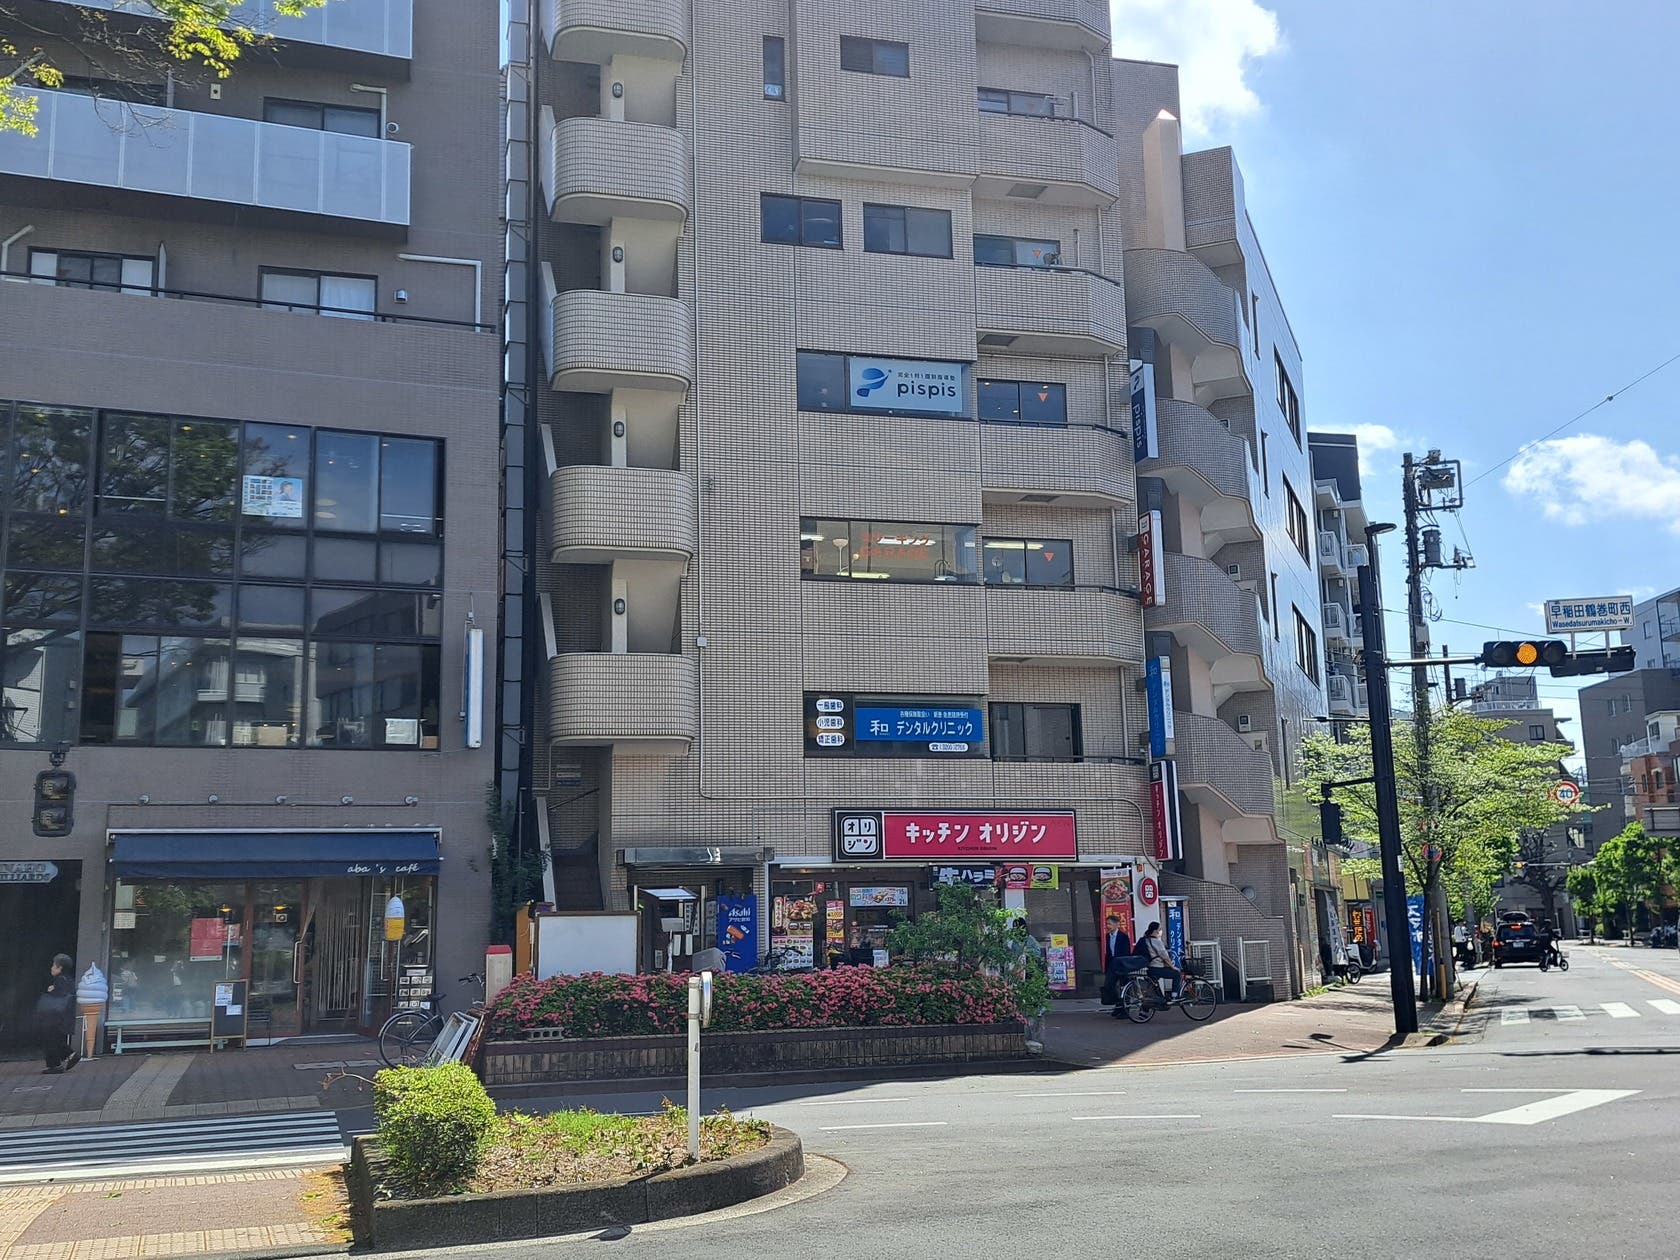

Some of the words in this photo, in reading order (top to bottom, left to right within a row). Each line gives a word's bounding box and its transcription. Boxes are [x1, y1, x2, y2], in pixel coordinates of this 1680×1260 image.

[897, 380, 956, 399] pispis
[1133, 403, 1143, 449] pispis
[1142, 533, 1153, 605] GARAGE
[1551, 601, 1631, 619] 早稲田鶴巻町西
[1552, 618, 1618, 628] Wasedatsurumakicho
[870, 719, 889, 736] 和
[896, 720, 973, 736] デンタルクリニック
[1559, 788, 1573, 799] 40
[905, 822, 970, 844] キッチン
[979, 821, 1046, 843] オリジン
[395, 862, 420, 874] café
[938, 867, 995, 886] 牛ハラミ
[728, 907, 751, 918] Asahi
[1169, 908, 1181, 920] 和
